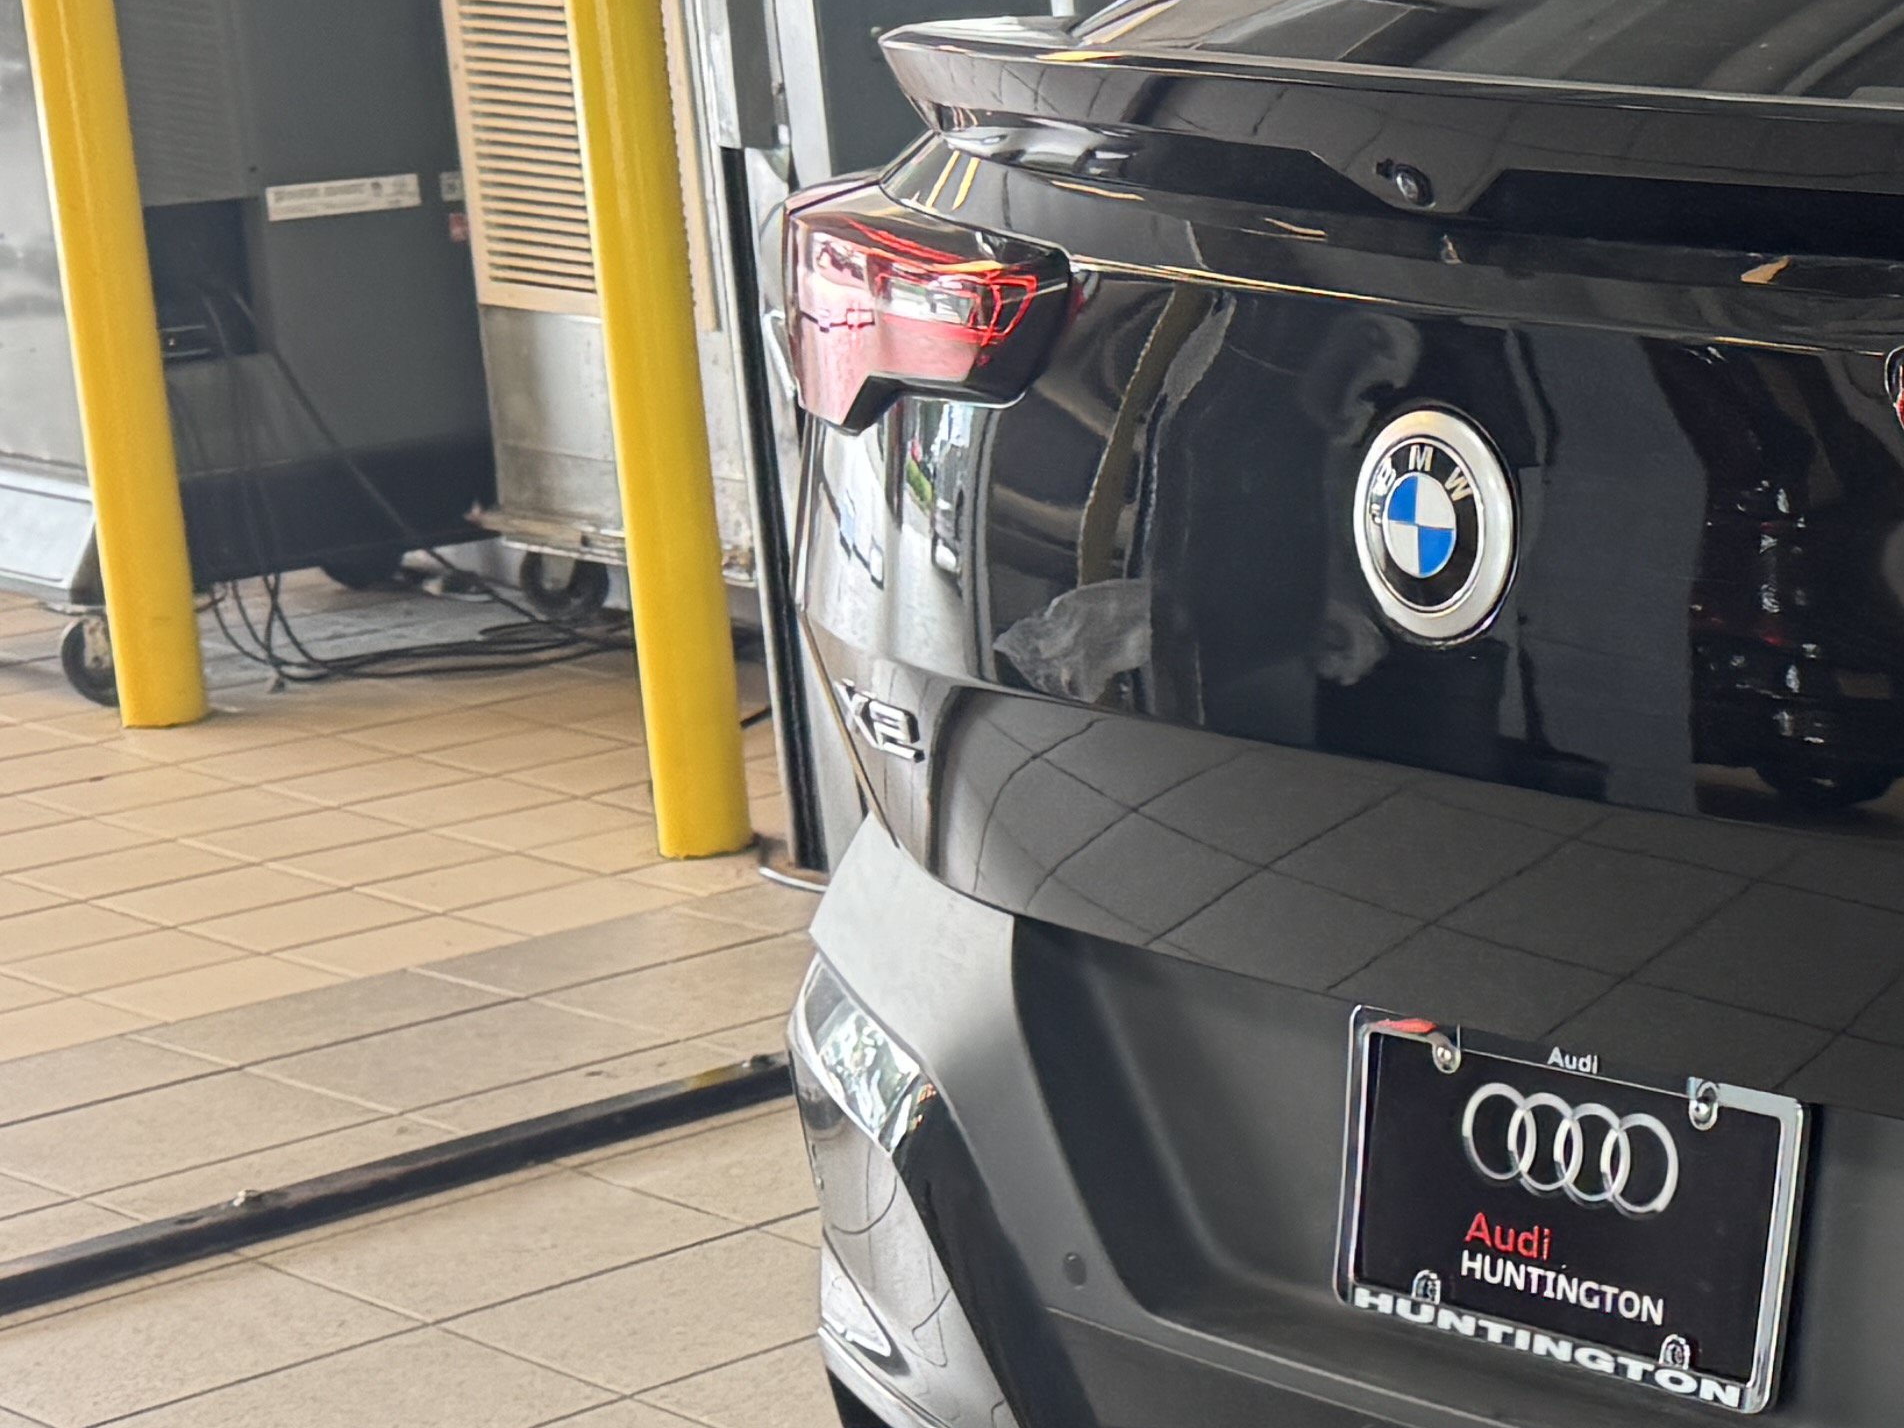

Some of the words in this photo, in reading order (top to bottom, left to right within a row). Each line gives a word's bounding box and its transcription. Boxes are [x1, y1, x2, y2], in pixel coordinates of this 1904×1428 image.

[1374, 445, 1474, 502] BMW
[1547, 1046, 1599, 1074] Audi
[1464, 1211, 1551, 1259] Audi
[1460, 1249, 1665, 1326] HUNTINGTON
[1353, 1287, 1743, 1408] HUNTINGTON
